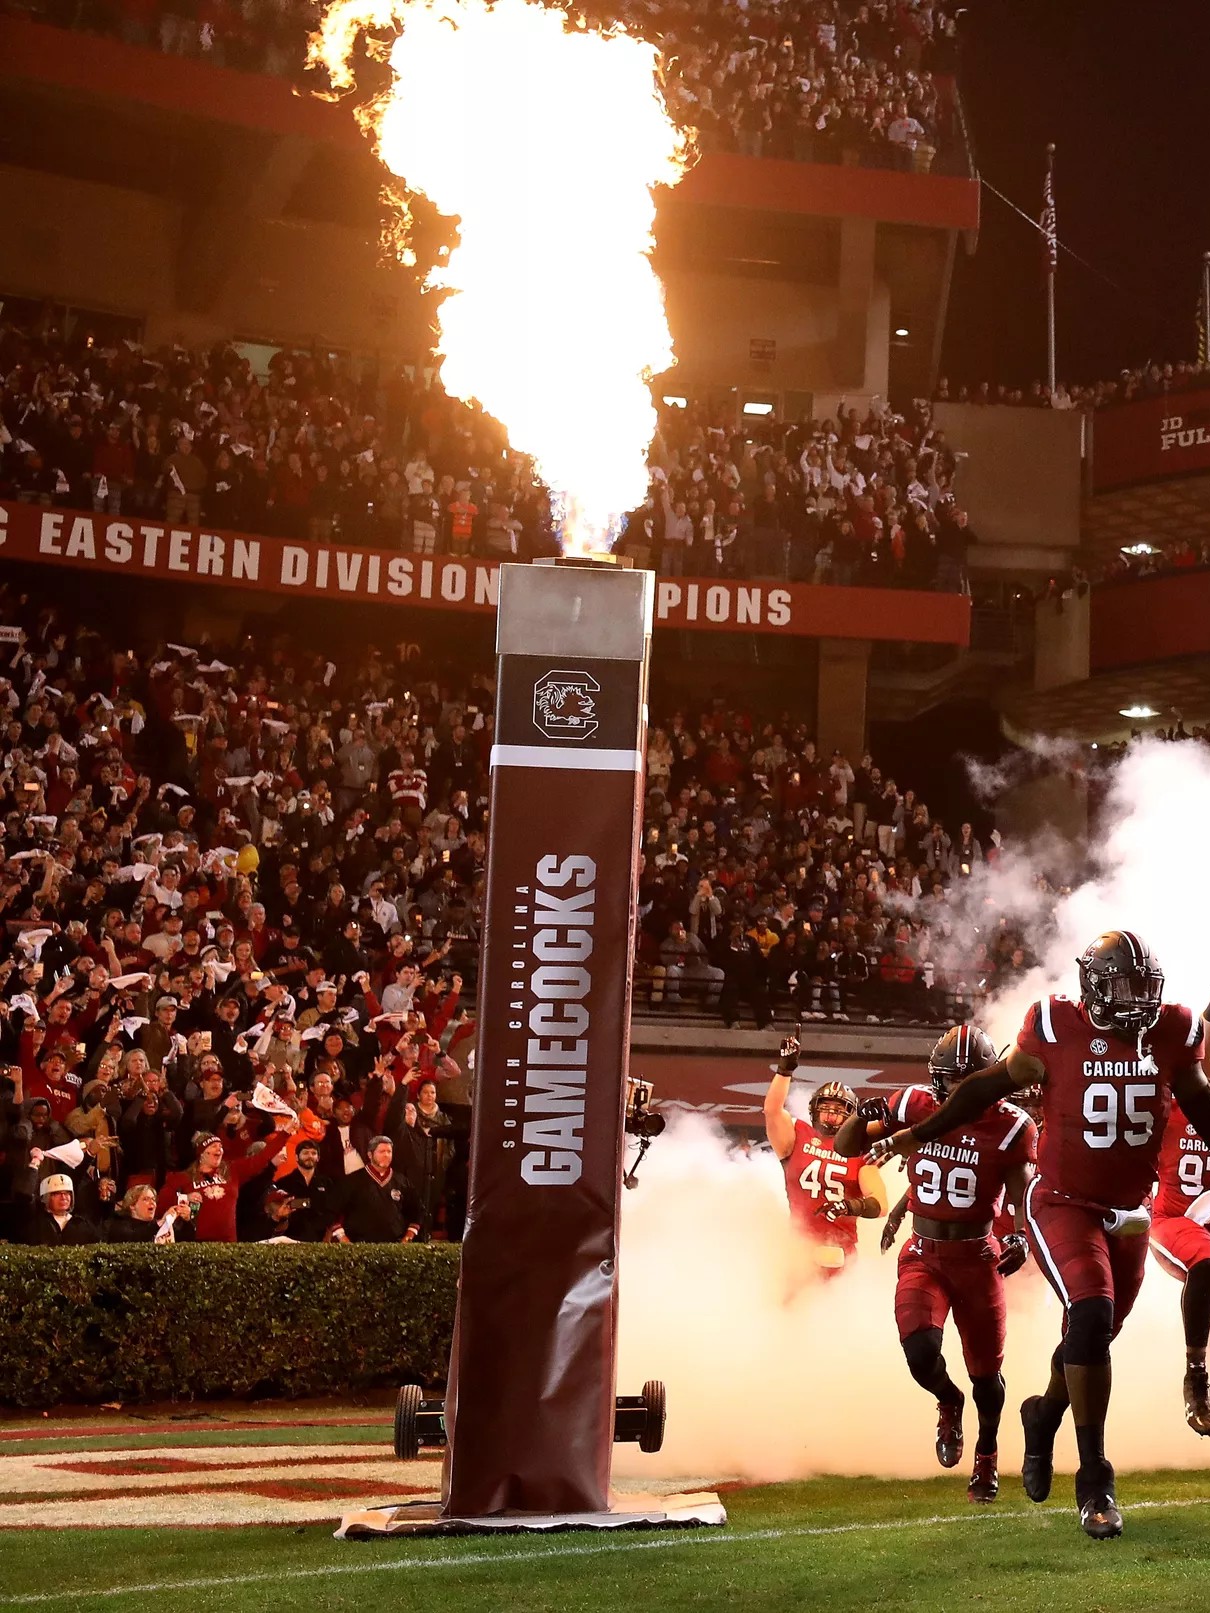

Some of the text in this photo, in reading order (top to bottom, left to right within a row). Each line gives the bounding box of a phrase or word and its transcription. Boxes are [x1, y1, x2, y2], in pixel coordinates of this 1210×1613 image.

[1161, 417, 1183, 431] JD
[38, 512, 260, 581] EASTERN
[281, 546, 499, 605] DIVISION
[503, 885, 530, 1149] SOUTH CAROLINA
[520, 854, 597, 1185] GAMECOCKS
[1082, 1083, 1156, 1148] 95
[799, 1160, 848, 1202] 45
